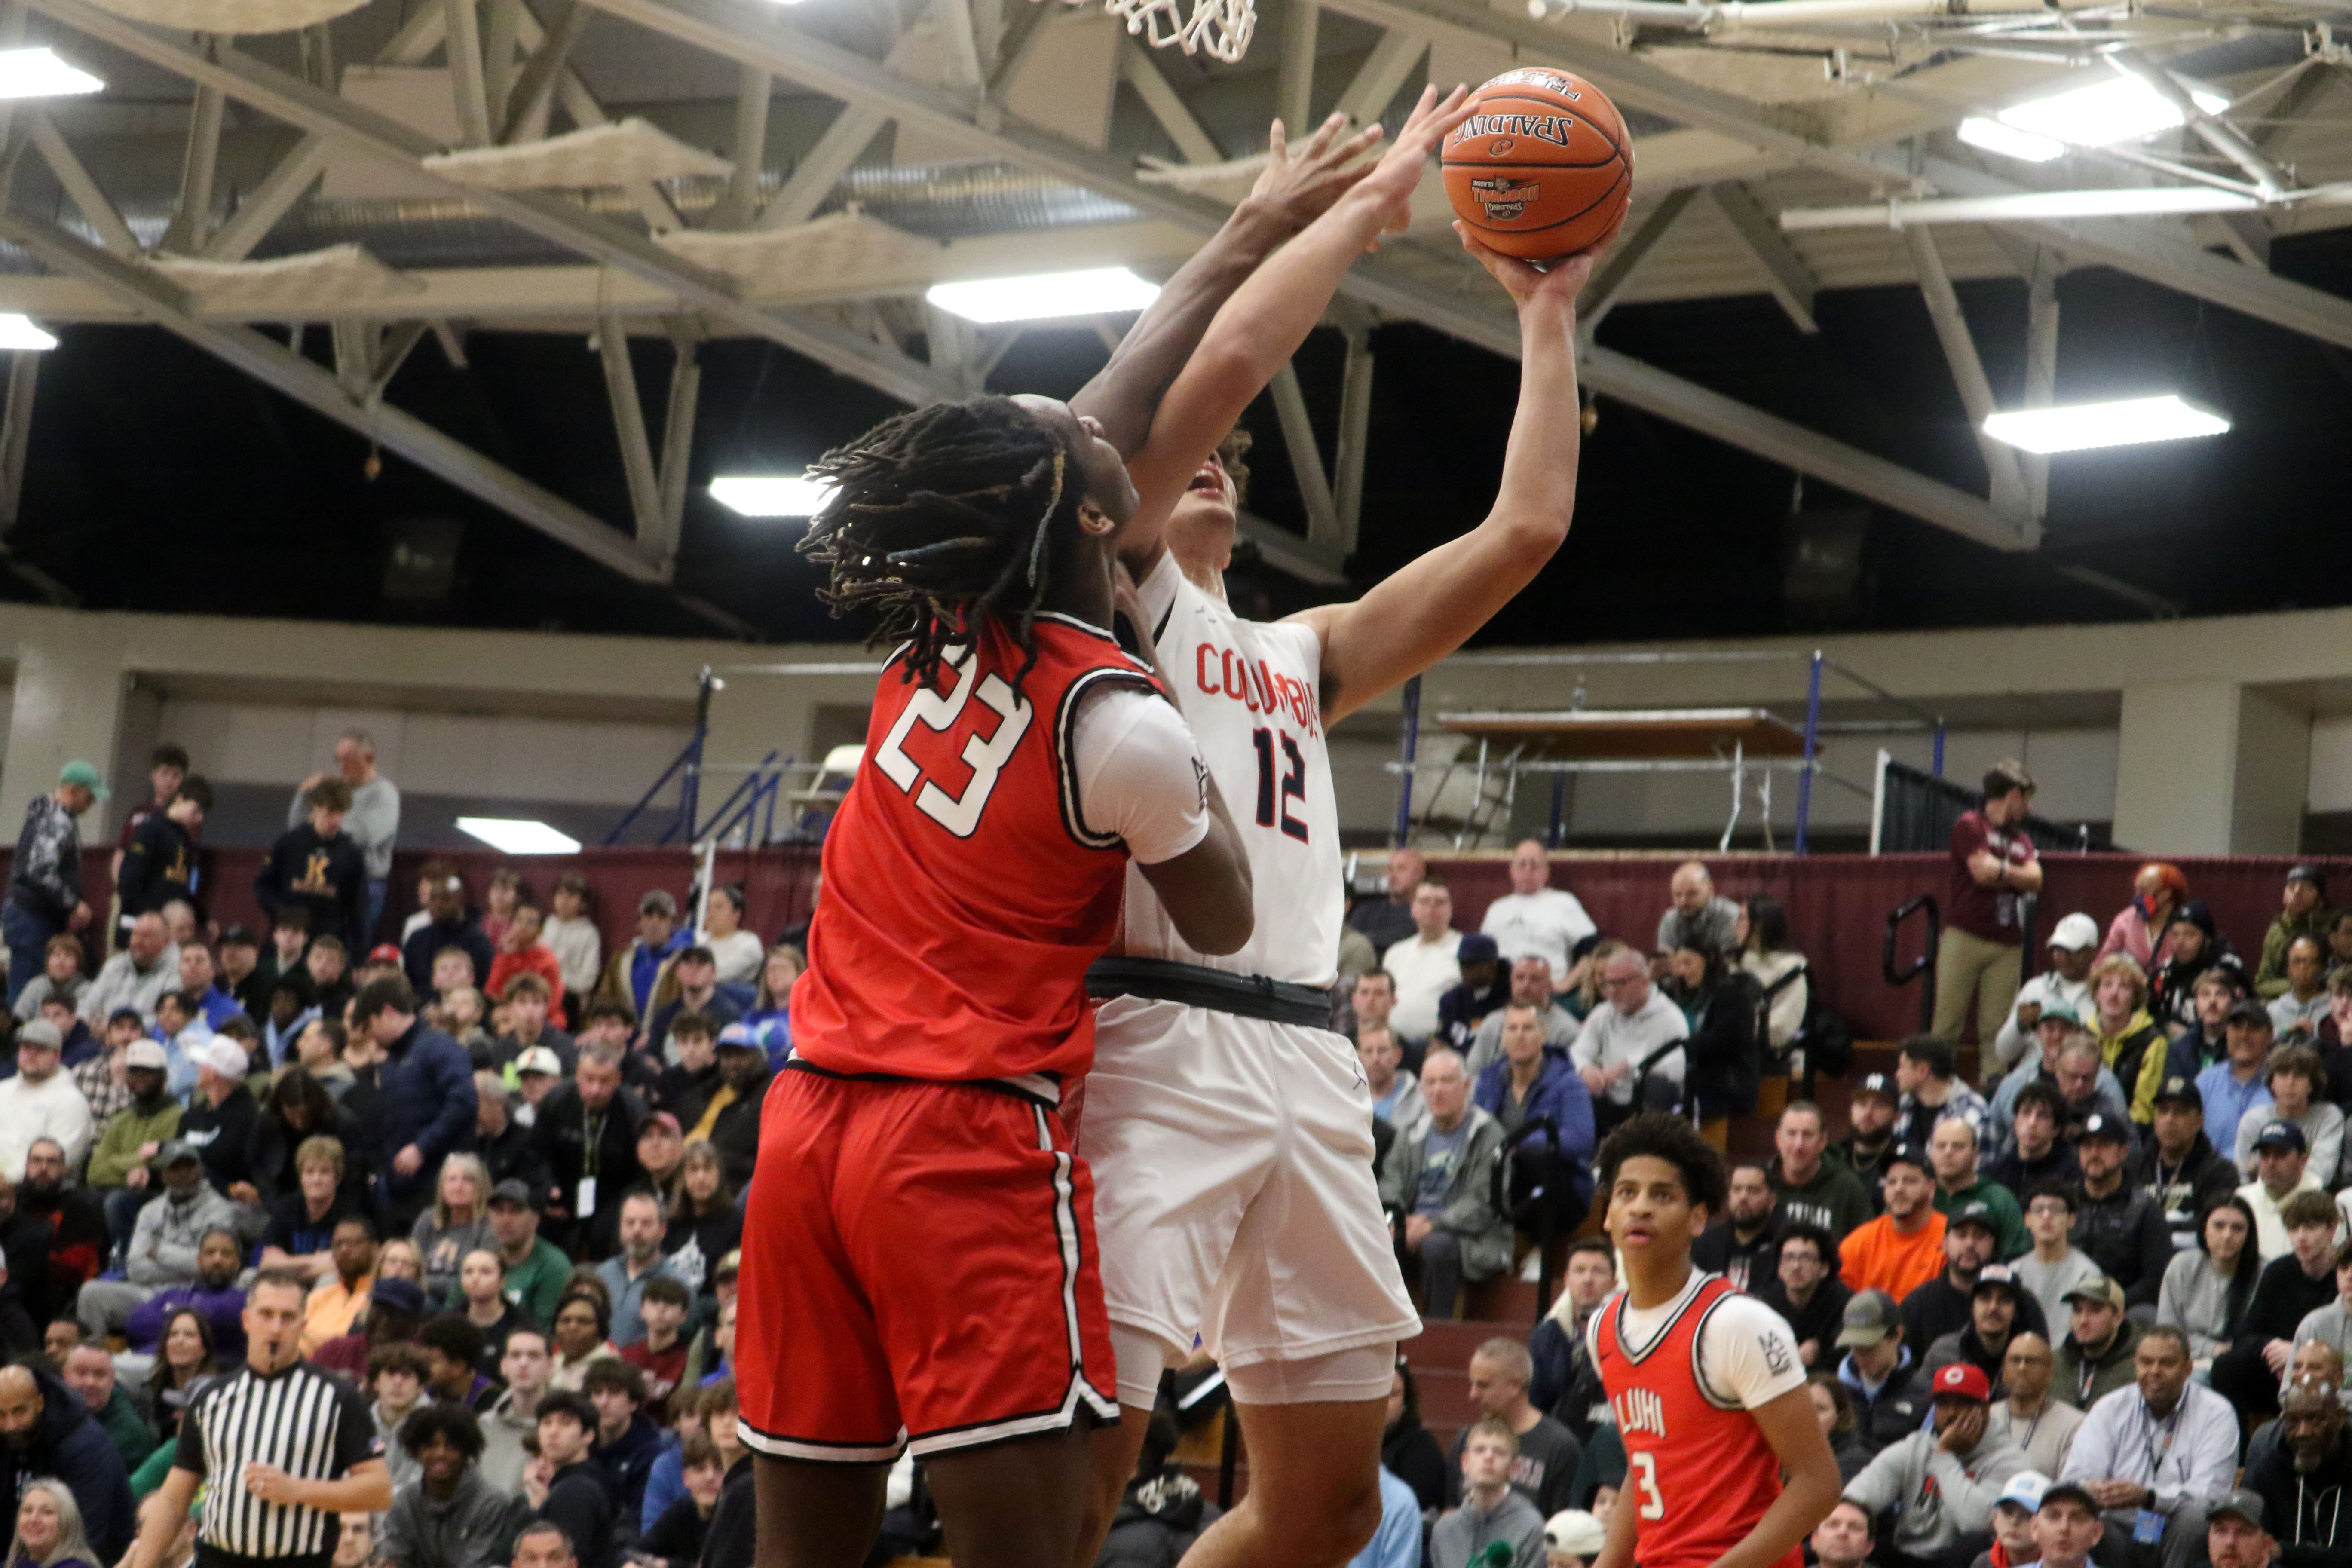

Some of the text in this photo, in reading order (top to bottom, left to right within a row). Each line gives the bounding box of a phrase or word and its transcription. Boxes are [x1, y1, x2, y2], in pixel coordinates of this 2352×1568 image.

[1454, 113, 1572, 147] SPALDING
[1488, 202, 1522, 211] SPALDING
[873, 643, 1033, 839] 23
[1253, 727, 1309, 845] 12
[1615, 1387, 1666, 1439] LUHI
[1632, 1451, 1665, 1520] 3
